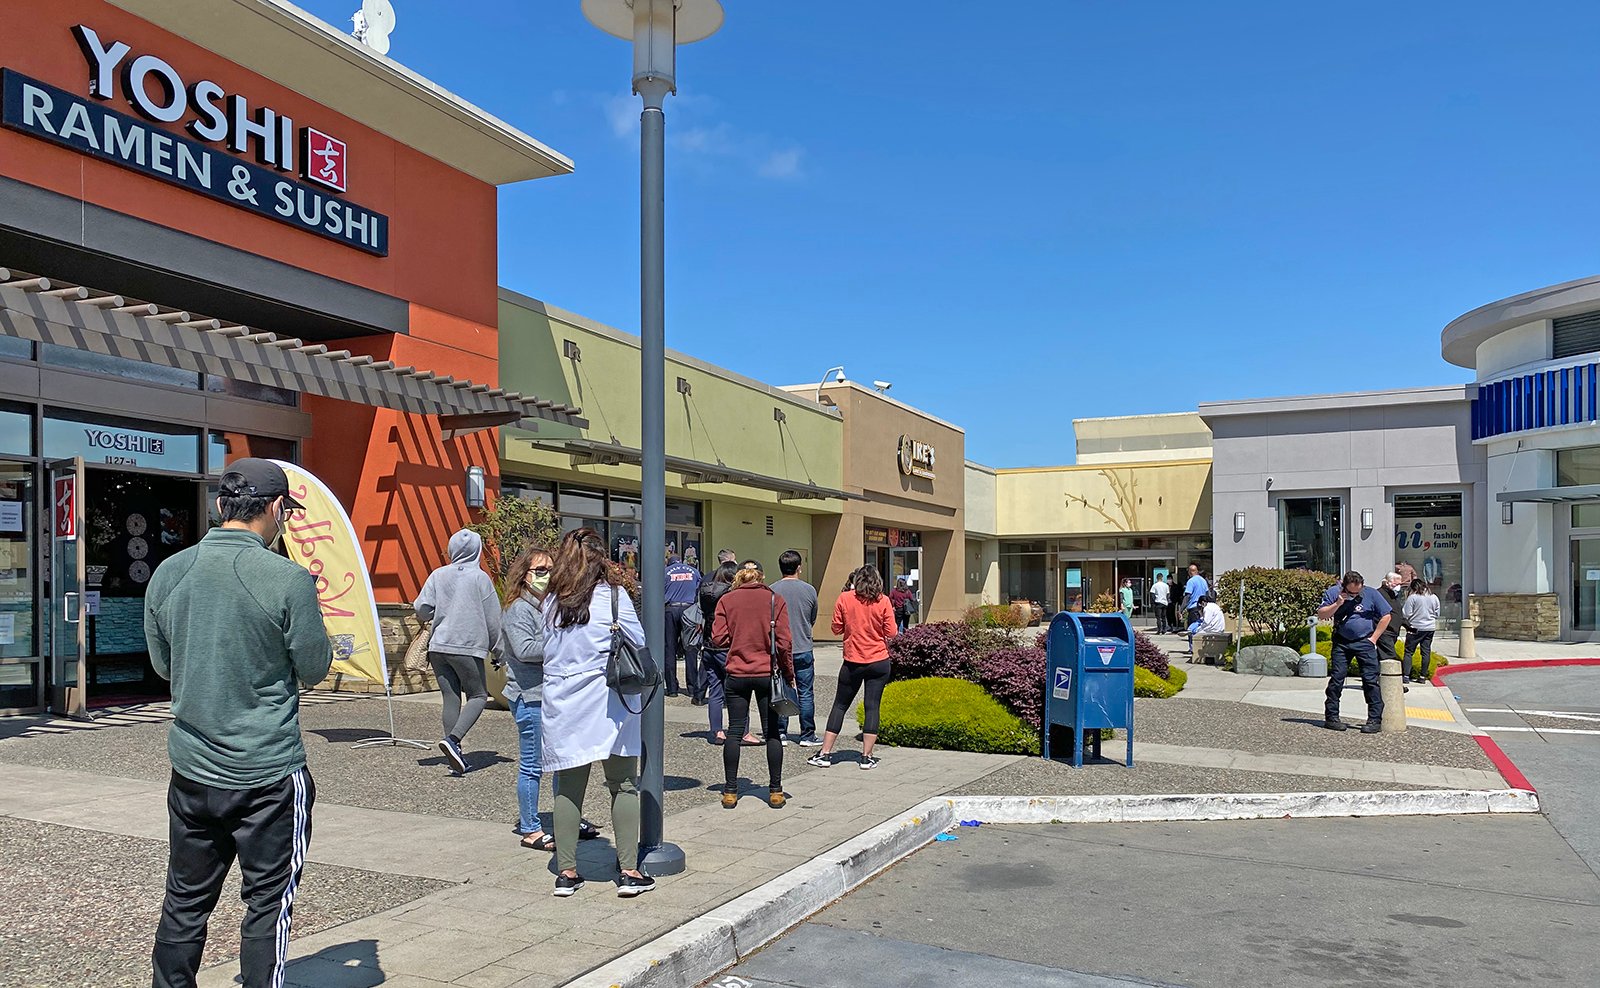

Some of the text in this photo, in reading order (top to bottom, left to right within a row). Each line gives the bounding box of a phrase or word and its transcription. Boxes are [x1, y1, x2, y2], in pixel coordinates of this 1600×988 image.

[73, 24, 293, 172] YOSHI
[22, 83, 379, 249] RAMEN & SUSHI
[84, 429, 147, 453] YOSHI
[1433, 541, 1458, 549] family
